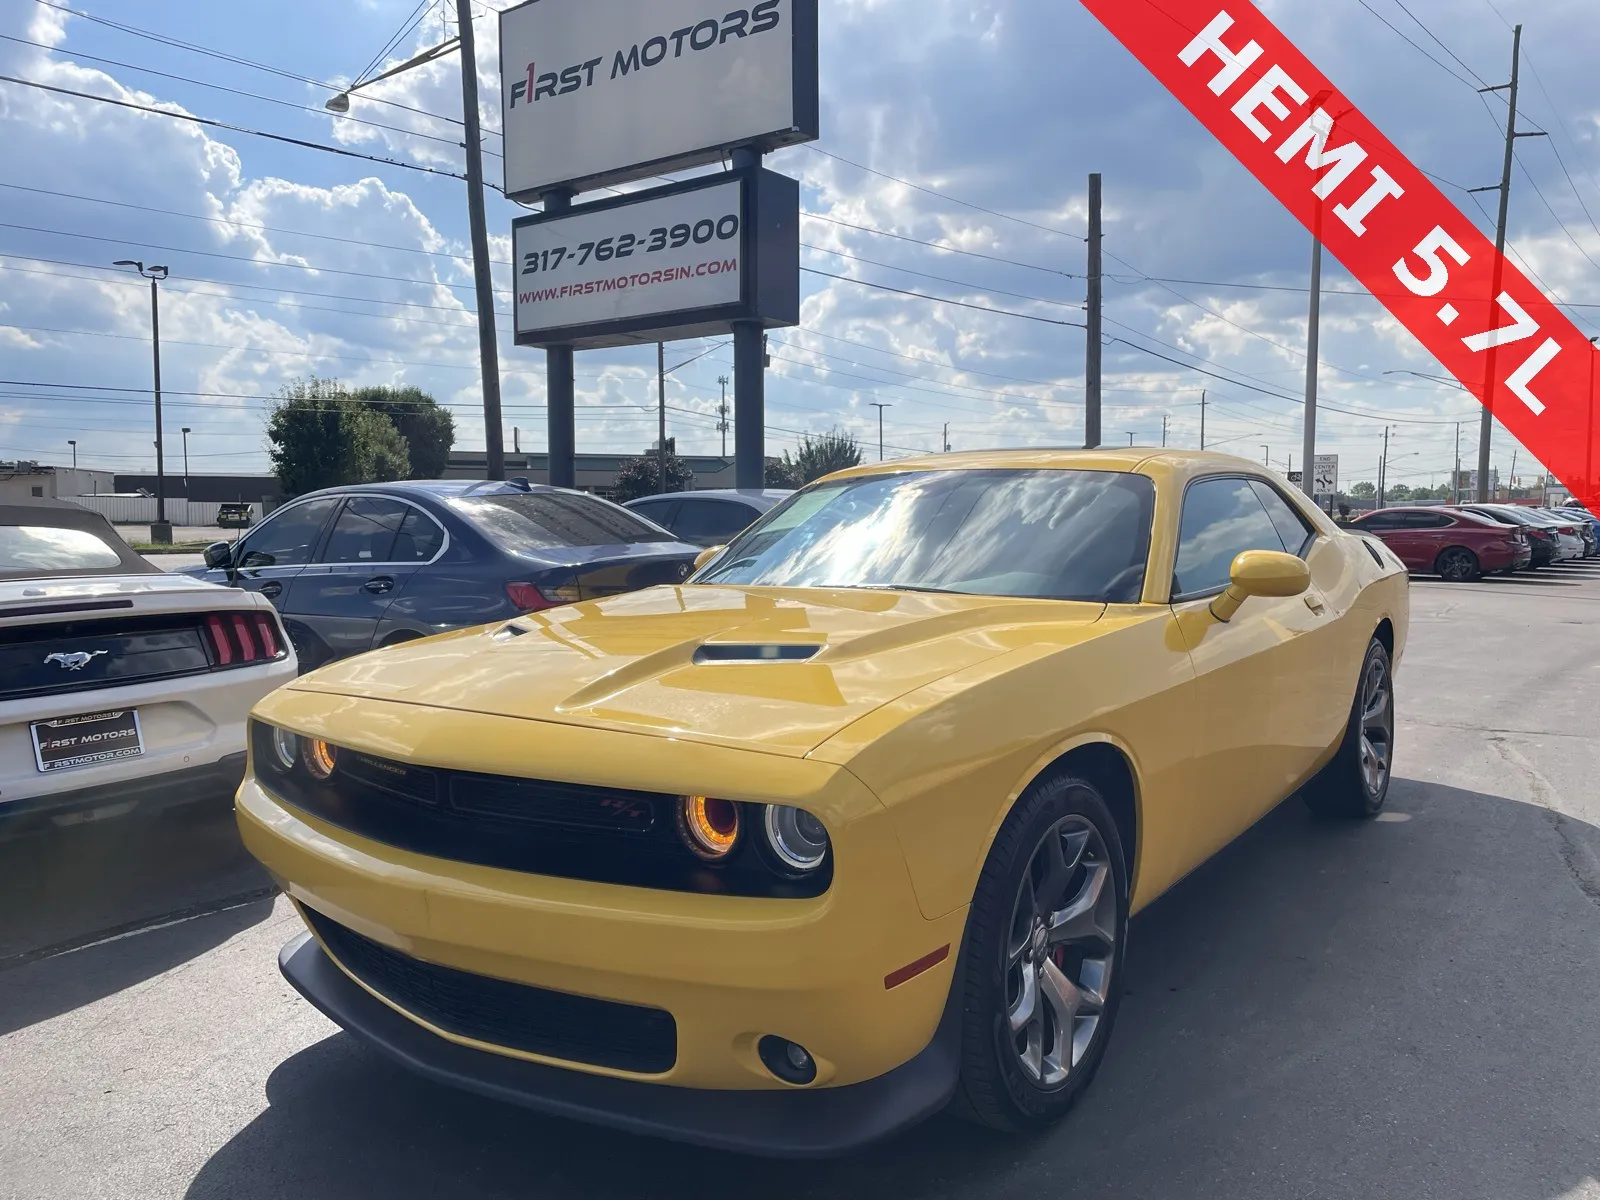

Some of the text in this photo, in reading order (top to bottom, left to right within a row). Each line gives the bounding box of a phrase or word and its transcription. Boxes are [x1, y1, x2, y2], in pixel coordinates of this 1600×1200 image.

[610, 0, 781, 80] MOTORS
[521, 213, 739, 275] 317-762-3900
[518, 257, 738, 305] WWW.FIRSTMOTORSIN.COM
[81, 712, 113, 722] MOTORS
[80, 728, 136, 744] MOTORS
[43, 747, 141, 770] FRSTMOTOR.COM
